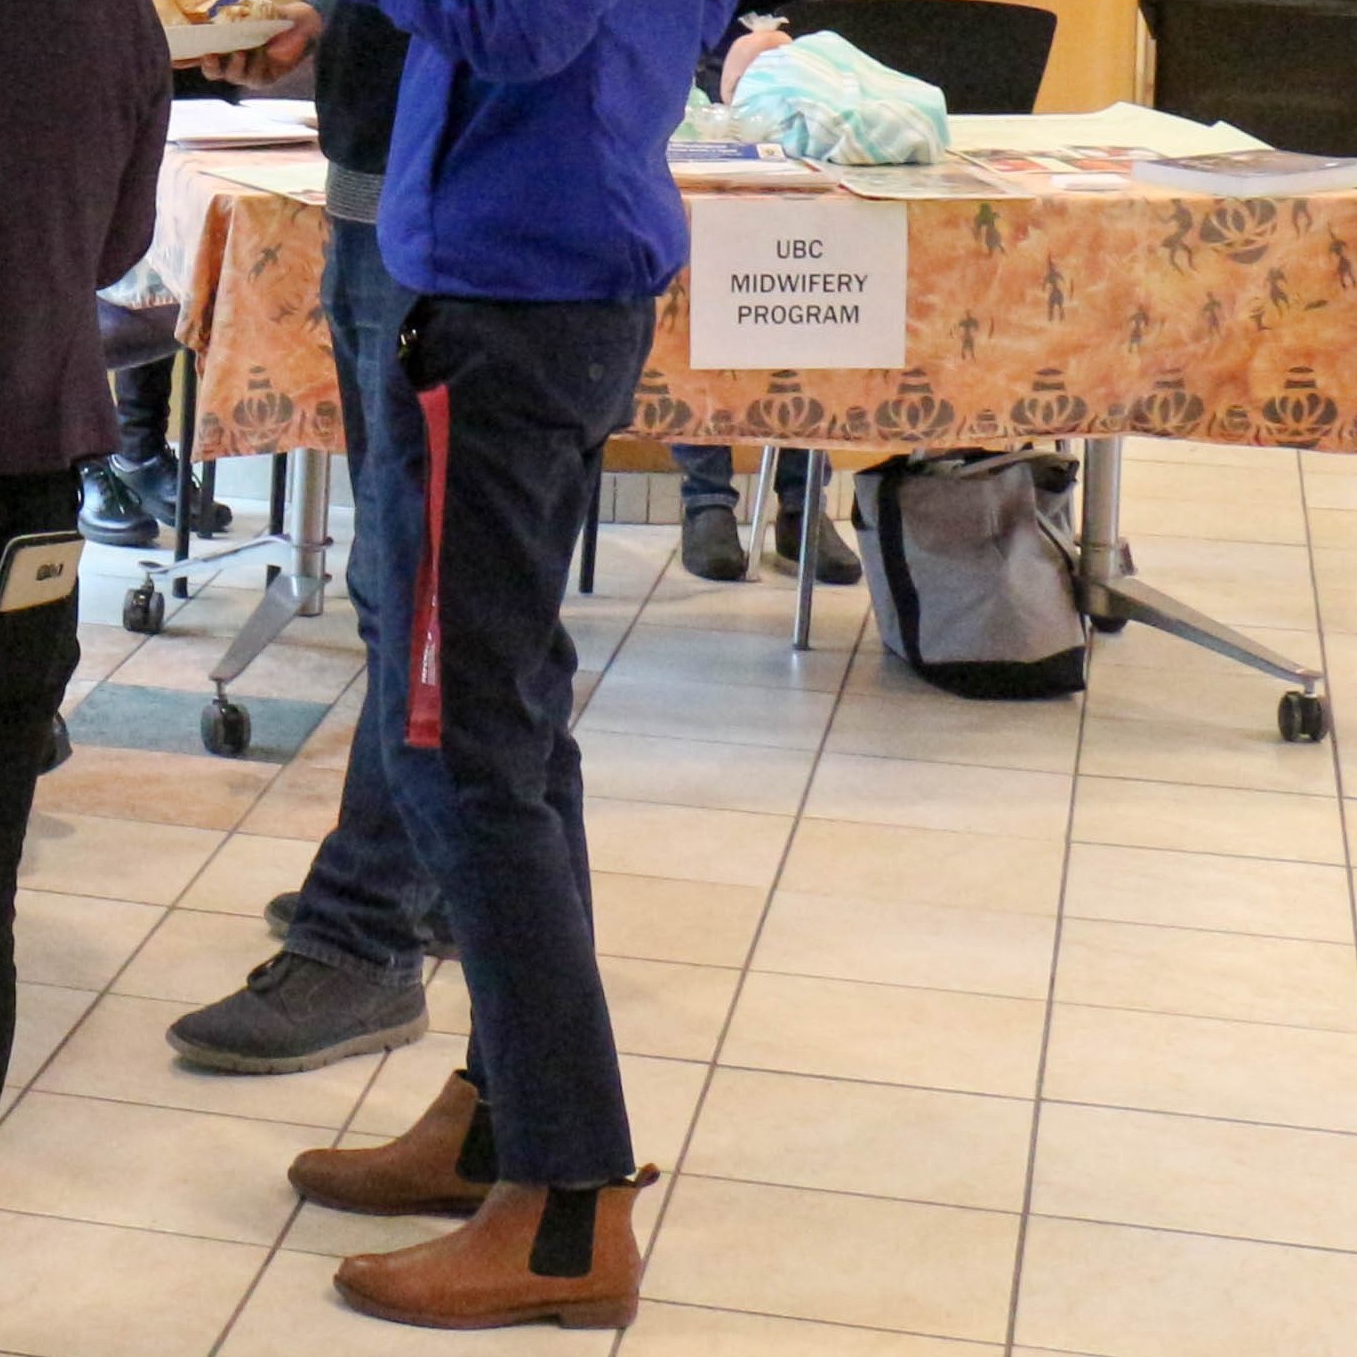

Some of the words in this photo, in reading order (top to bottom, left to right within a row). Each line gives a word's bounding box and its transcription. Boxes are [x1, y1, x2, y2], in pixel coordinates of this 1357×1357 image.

[776, 239, 823, 259] UBC
[731, 273, 868, 293] MIDWIFERY
[737, 305, 860, 324] PROGRAM
